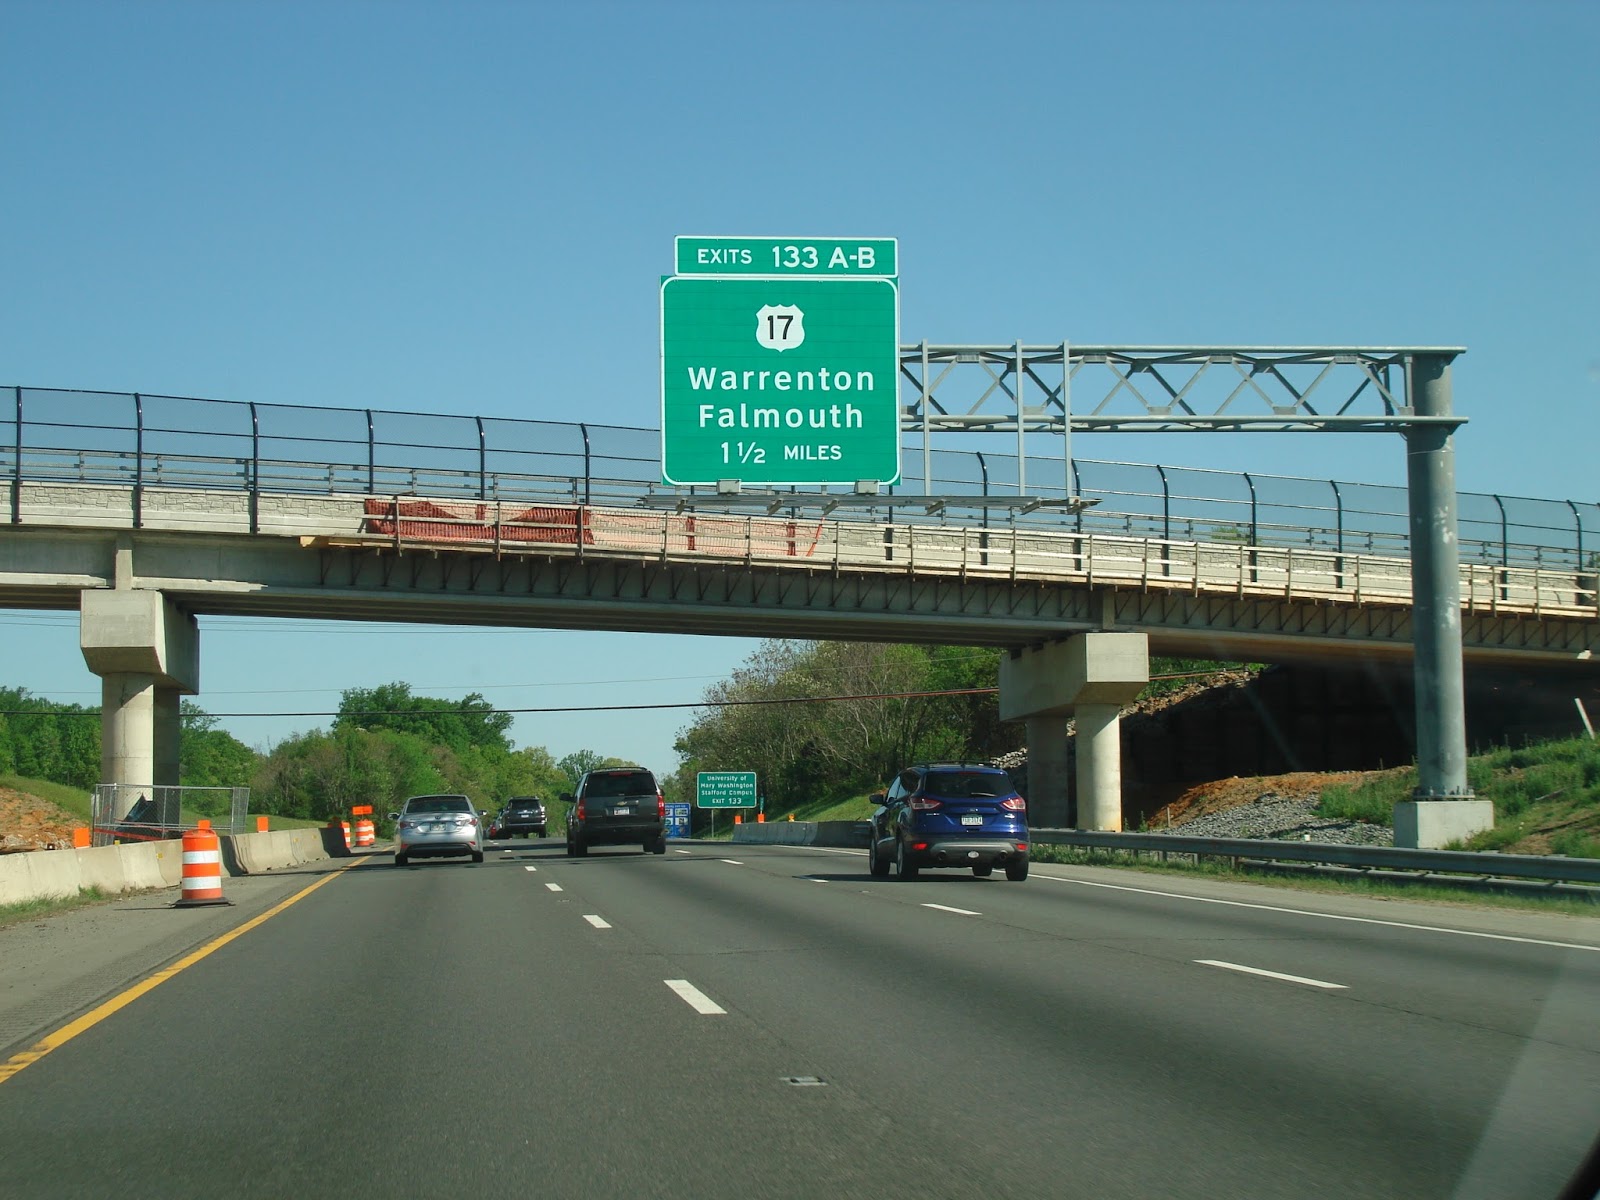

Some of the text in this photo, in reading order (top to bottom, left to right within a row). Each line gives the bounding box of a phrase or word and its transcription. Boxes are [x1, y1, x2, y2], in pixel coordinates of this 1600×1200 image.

[697, 246, 876, 269] EXITS 133 A-B
[767, 315, 794, 340] 17
[688, 367, 874, 391] Warrenton
[699, 403, 863, 428] Falmouth
[784, 445, 842, 460] MILES
